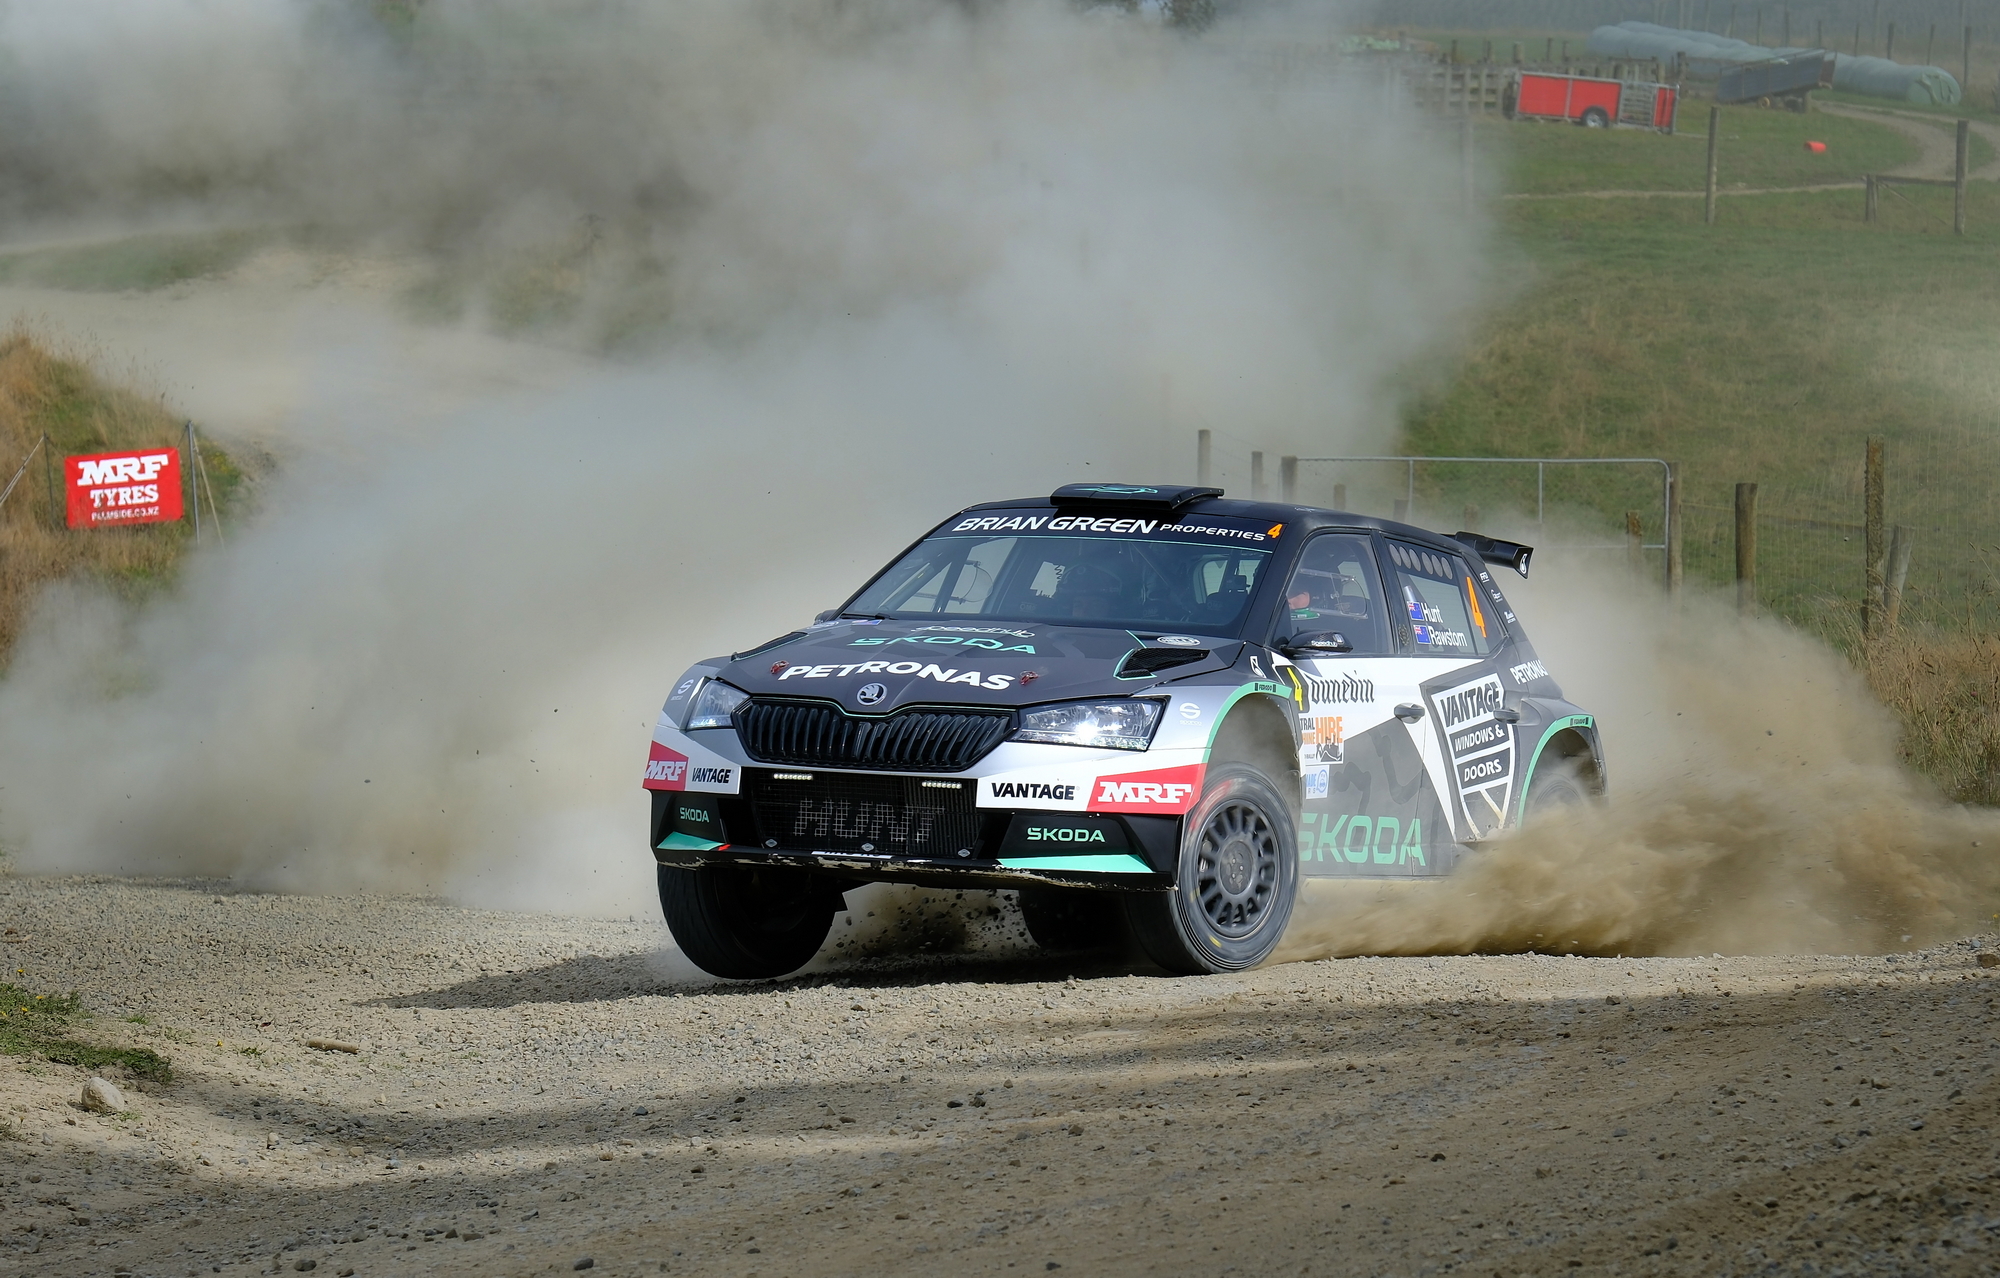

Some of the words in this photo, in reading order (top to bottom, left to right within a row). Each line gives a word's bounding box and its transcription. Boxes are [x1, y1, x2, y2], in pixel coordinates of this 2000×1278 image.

[77, 454, 168, 487] MRF
[90, 484, 159, 508] TYRES
[952, 516, 1048, 532] BRIAN
[1047, 516, 1159, 533] GREEN
[1159, 523, 1266, 541] PROPERTIES
[1267, 523, 1283, 539] 4
[1421, 602, 1443, 623] Hunt
[1466, 576, 1487, 638] 4
[778, 660, 1016, 690] PETRONAS
[1287, 667, 1303, 711] 4
[1440, 681, 1501, 728] VANTAGE
[1315, 716, 1343, 744] HIRE
[1455, 726, 1494, 751] WINDOWS
[1495, 724, 1505, 738] &
[645, 760, 687, 782] MRF
[692, 767, 731, 784] VANTAGE
[1464, 759, 1502, 782] DOORS
[991, 782, 1075, 801] VANTAGE
[1097, 781, 1192, 804] MRF
[793, 798, 945, 843] HUNT
